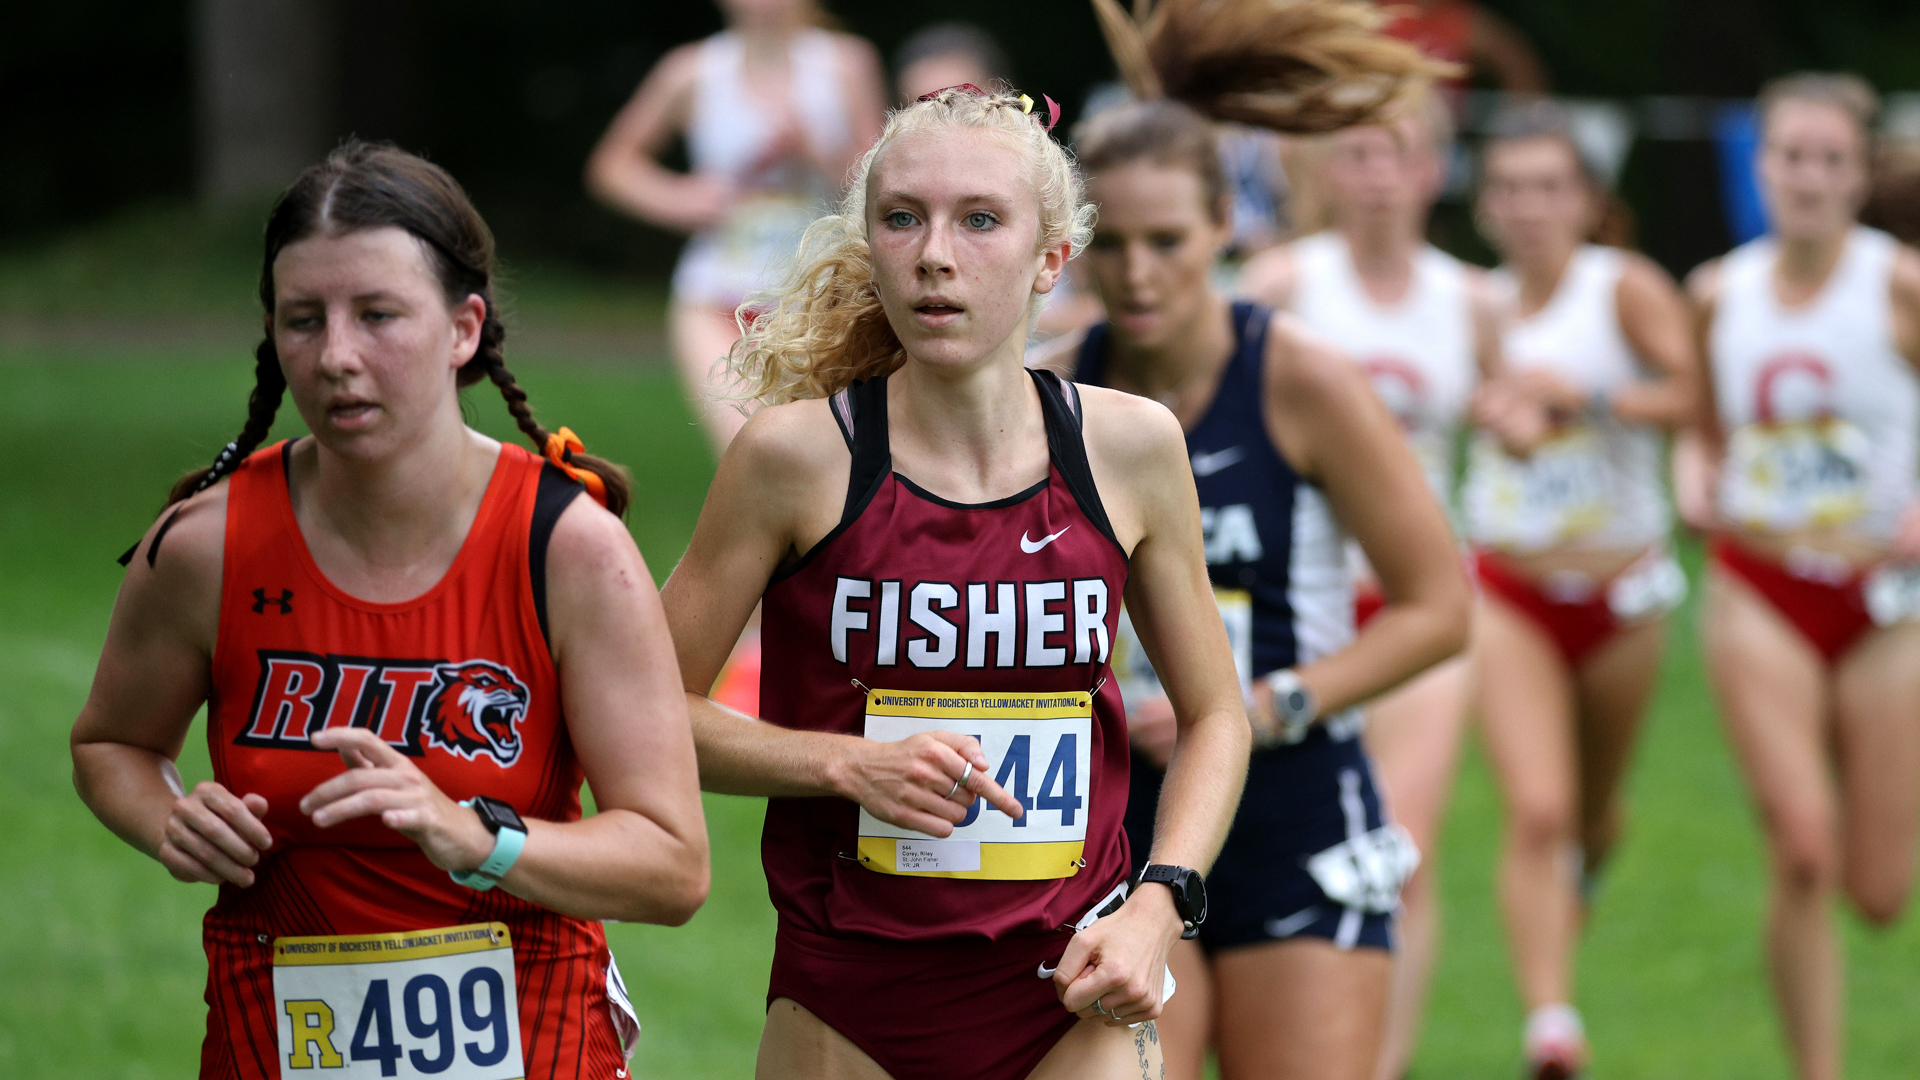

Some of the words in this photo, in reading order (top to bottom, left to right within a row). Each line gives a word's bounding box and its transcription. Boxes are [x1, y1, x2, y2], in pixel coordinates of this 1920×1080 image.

[829, 574, 1110, 671] FISHER
[244, 656, 437, 748] RIT
[881, 695, 925, 707] UNIVERSITY
[926, 697, 936, 708] OF
[937, 698, 979, 708] ROCHESTER
[980, 698, 1034, 709] YELLOWJACKET
[1035, 697, 1078, 709] INVITATIONAL
[285, 942, 327, 954] UNIVERSITY
[328, 942, 337, 953] OF
[338, 940, 382, 952] ROCHESTER
[383, 934, 442, 950] YELLOWJACKET
[444, 929, 494, 943] INVITATIONA
[284, 999, 344, 1069] R
[350, 966, 510, 1077] 499
